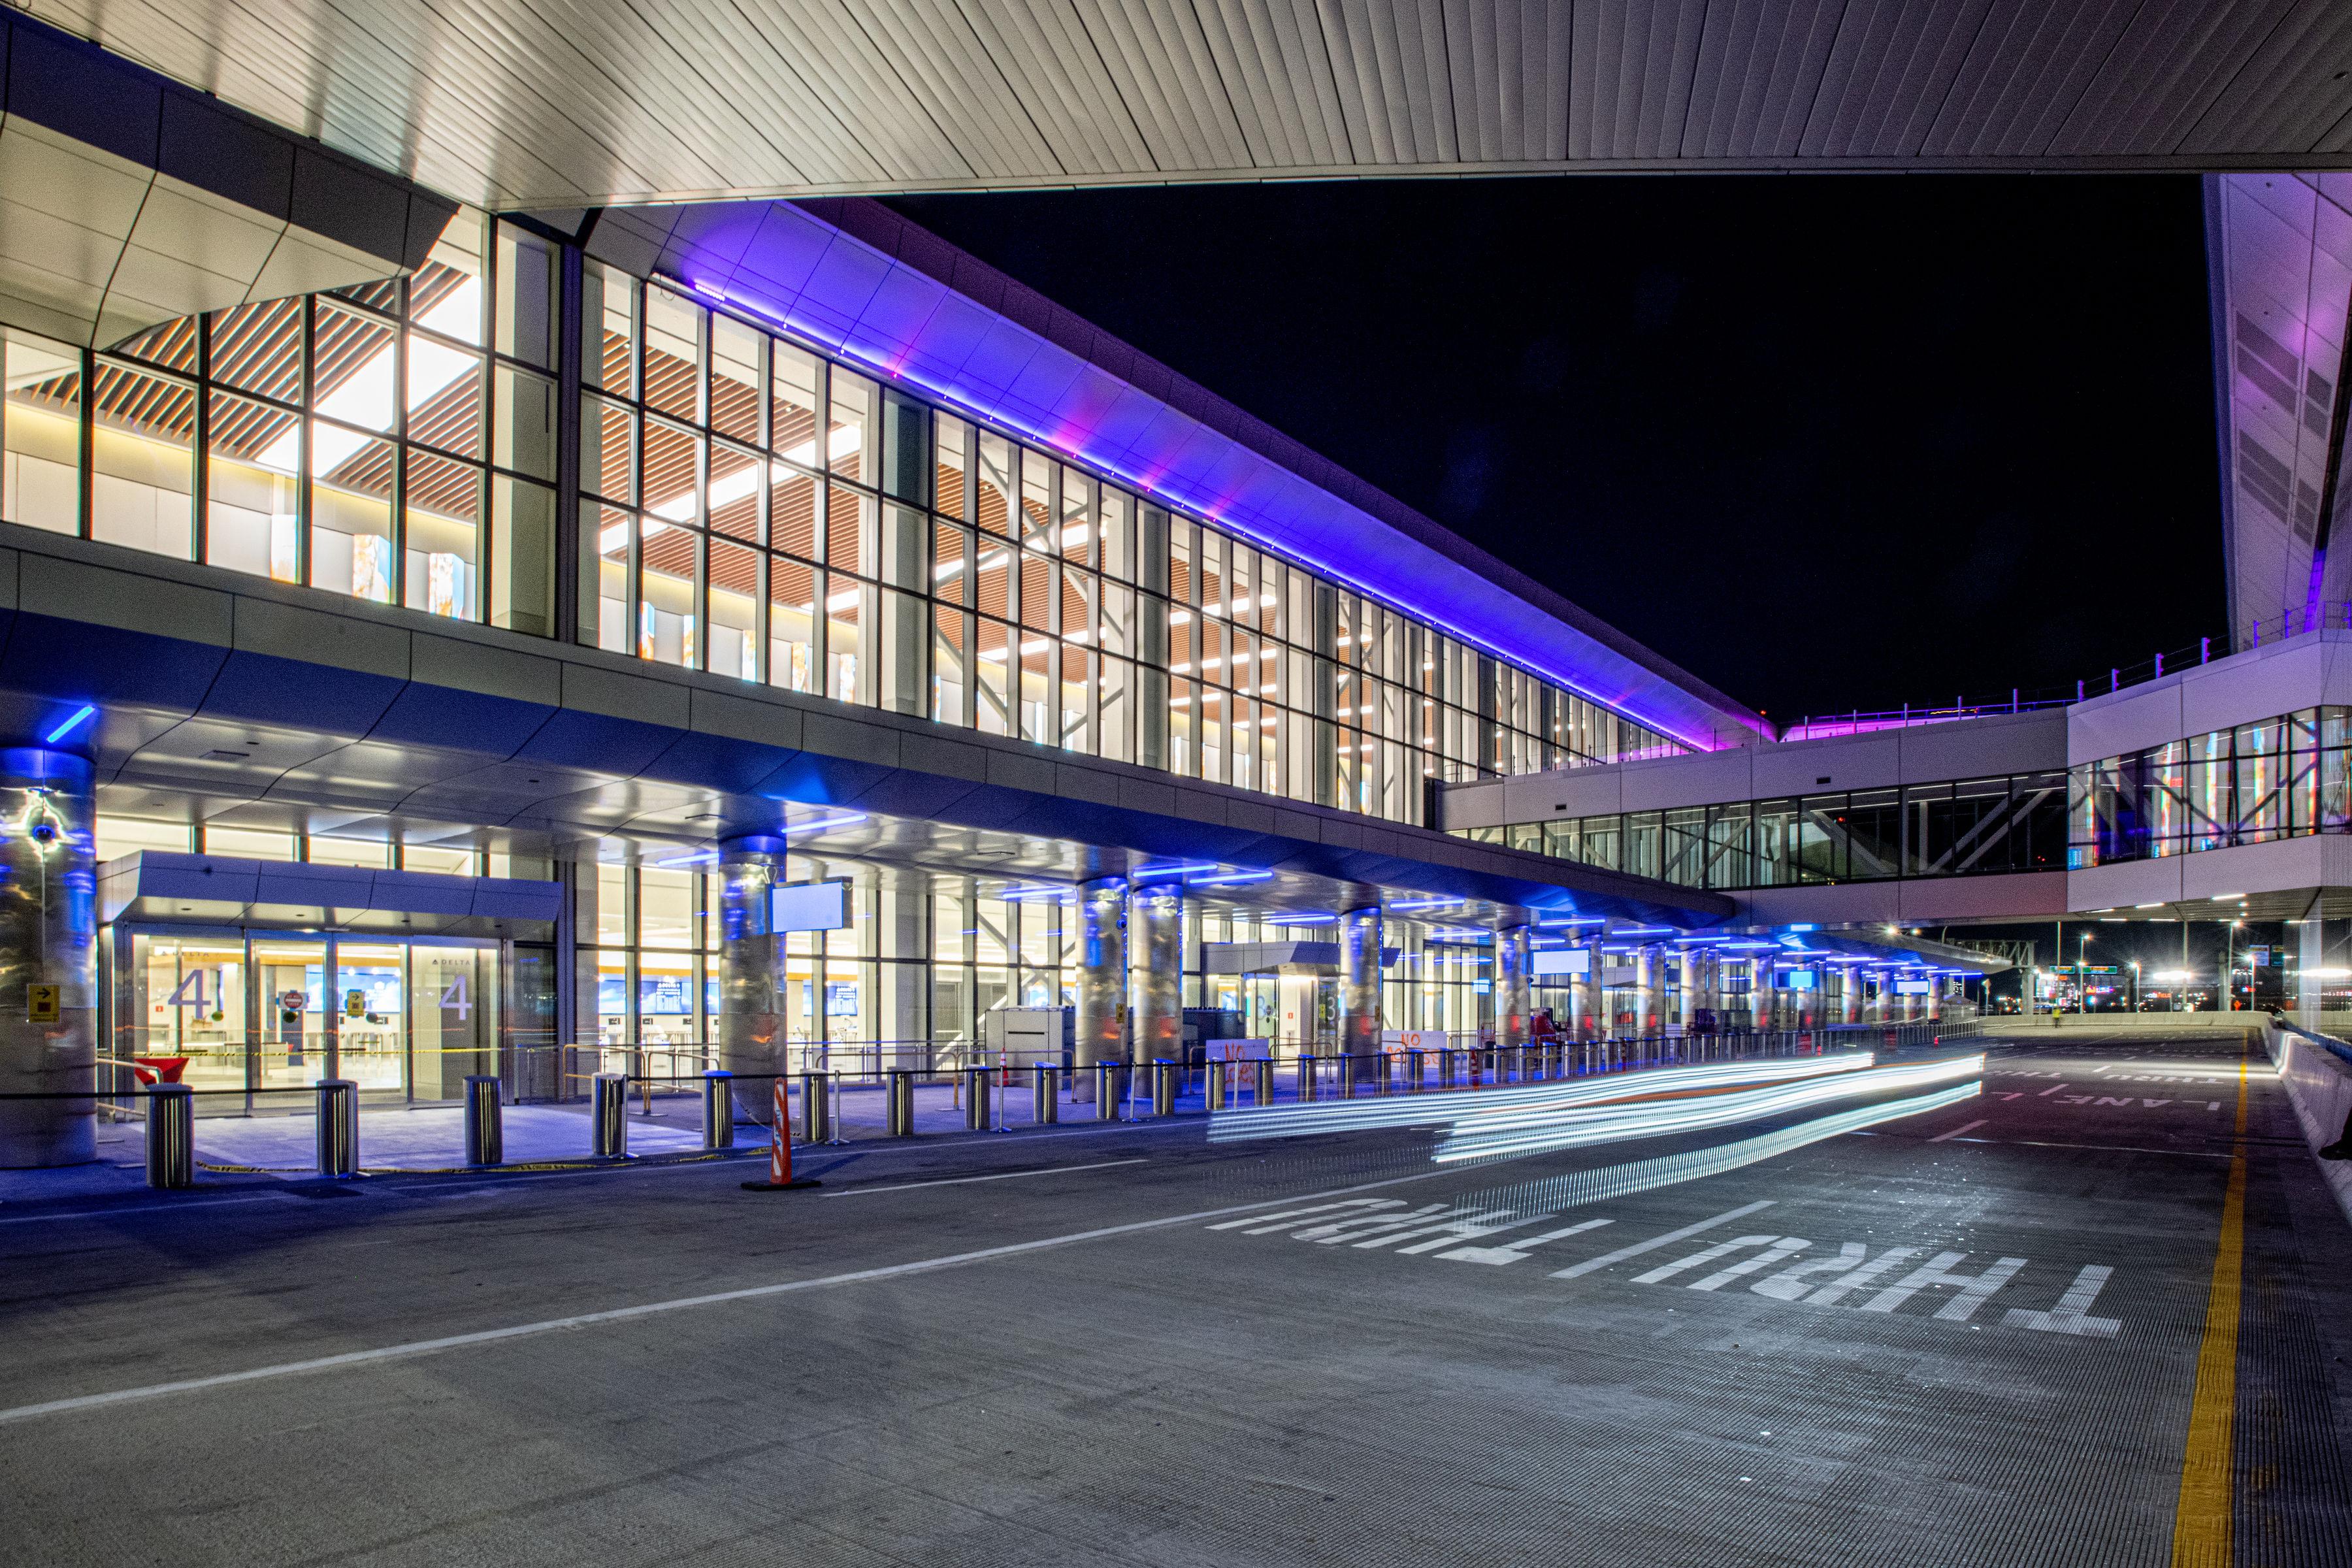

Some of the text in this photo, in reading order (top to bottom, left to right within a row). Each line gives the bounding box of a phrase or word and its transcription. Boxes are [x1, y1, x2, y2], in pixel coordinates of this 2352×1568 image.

[168, 969, 211, 1019] 4
[438, 974, 472, 1021] 4
[1328, 996, 1336, 1021] 3
[1401, 1034, 1420, 1046] NO
[2102, 1074, 2224, 1084] THRU
[2052, 1095, 2221, 1111] LANE
[1203, 1198, 1616, 1266] THRU
[1629, 1235, 2123, 1339] THRU
